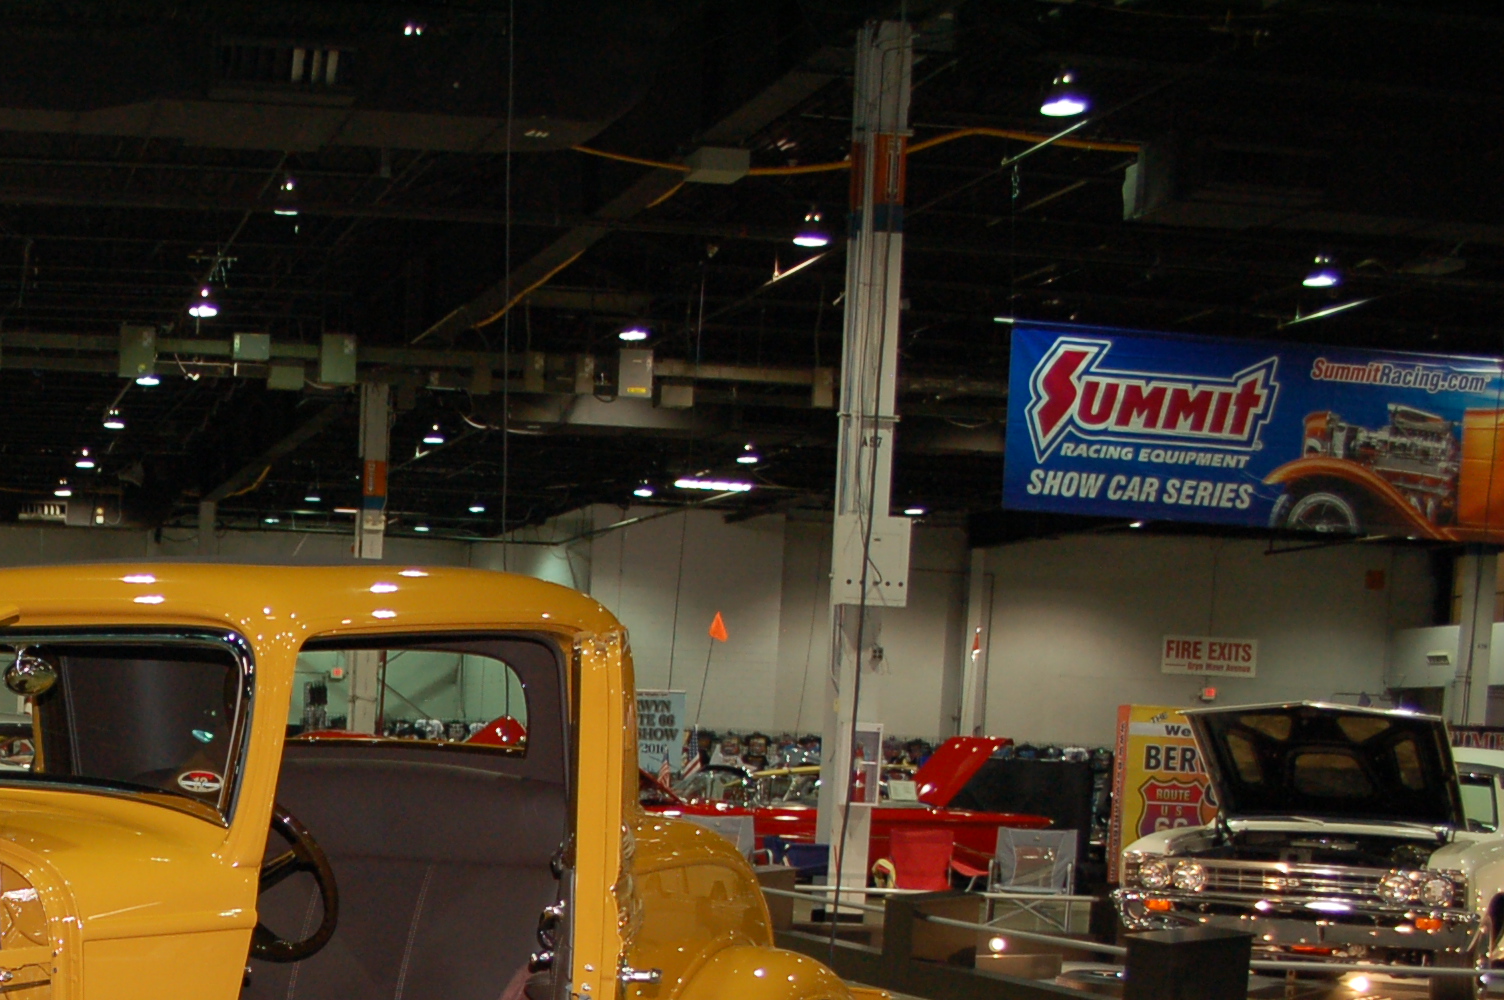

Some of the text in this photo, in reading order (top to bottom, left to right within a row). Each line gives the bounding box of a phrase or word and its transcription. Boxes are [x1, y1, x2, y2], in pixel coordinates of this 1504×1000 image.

[1311, 357, 1486, 393] SummitRacing.com
[1036, 347, 1268, 447] Summit
[1061, 442, 1250, 468] RACING EQUIPMENT
[1027, 468, 1253, 509] SHOW CAR SERIES
[1166, 640, 1251, 663] FIRE EXITS
[1156, 788, 1191, 800] ROUTE
